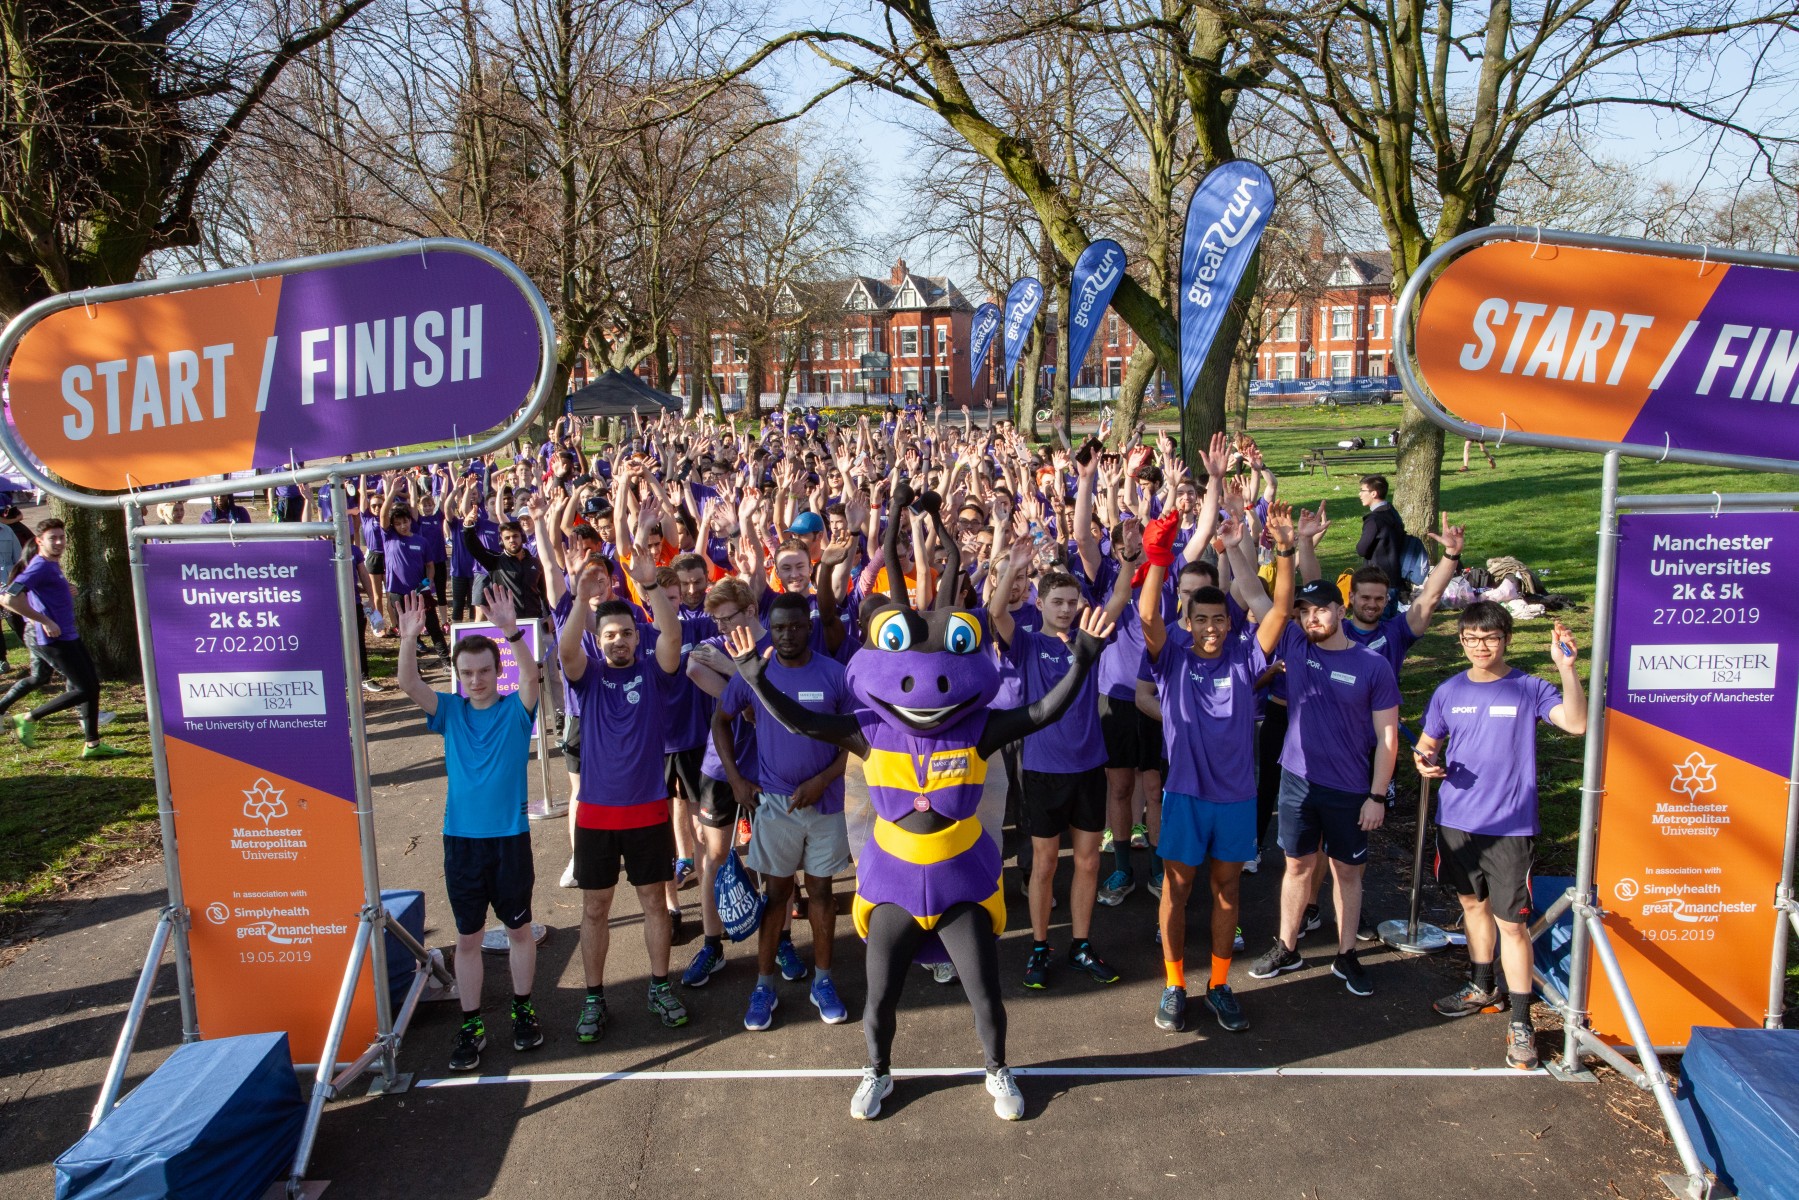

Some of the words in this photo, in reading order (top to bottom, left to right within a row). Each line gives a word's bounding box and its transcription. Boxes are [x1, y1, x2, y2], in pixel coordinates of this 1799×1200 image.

[1188, 241, 1228, 308] great
[1220, 177, 1260, 233] run
[1074, 287, 1099, 328] great
[1093, 248, 1118, 283] run
[1007, 310, 1025, 341] great
[1021, 283, 1038, 308] run
[1460, 298, 1654, 385] START
[1648, 320, 1699, 390] /
[61, 343, 233, 440] START
[256, 336, 278, 412] /
[301, 304, 483, 405] FINISH
[1653, 534, 1773, 551] Manchester
[181, 563, 297, 580] Manchester
[1650, 558, 1771, 576] Universities
[182, 587, 301, 604] Universities
[1672, 584, 1696, 600] 2k
[1700, 583, 1715, 599] &
[1719, 583, 1744, 599] 5k
[210, 612, 233, 628] 2k
[238, 612, 252, 627] &
[257, 611, 280, 627] 5k
[1653, 608, 1760, 624] 27.02.2019
[195, 635, 299, 653] 27.02.2019
[1638, 654, 1770, 670] MANCHESTER
[1712, 671, 1741, 683] 1824
[189, 681, 319, 698] MANCHESTER
[264, 698, 292, 709] 1824
[1628, 693, 1646, 703] The
[1648, 693, 1698, 705] University
[1700, 692, 1712, 702] of
[1713, 692, 1774, 702] Manchester
[1451, 706, 1477, 714] SPORT
[184, 721, 203, 730] The
[206, 719, 254, 731] University
[257, 719, 267, 729] of
[269, 719, 327, 729] Manchester
[1656, 803, 1728, 812] Manchester
[1652, 815, 1730, 825] Metropolitan
[233, 828, 302, 837] Manchester
[1661, 827, 1719, 837] University
[231, 840, 307, 849] Metropolitan
[242, 851, 298, 861] University
[243, 890, 288, 898] association
[1644, 884, 1721, 895] Simplyhealth
[234, 907, 309, 919] Simplyhealth
[1685, 901, 1757, 913] manchester
[278, 924, 347, 935] manchester
[1641, 929, 1714, 941] 19.05.2019
[240, 951, 311, 963] 19.05.2019
